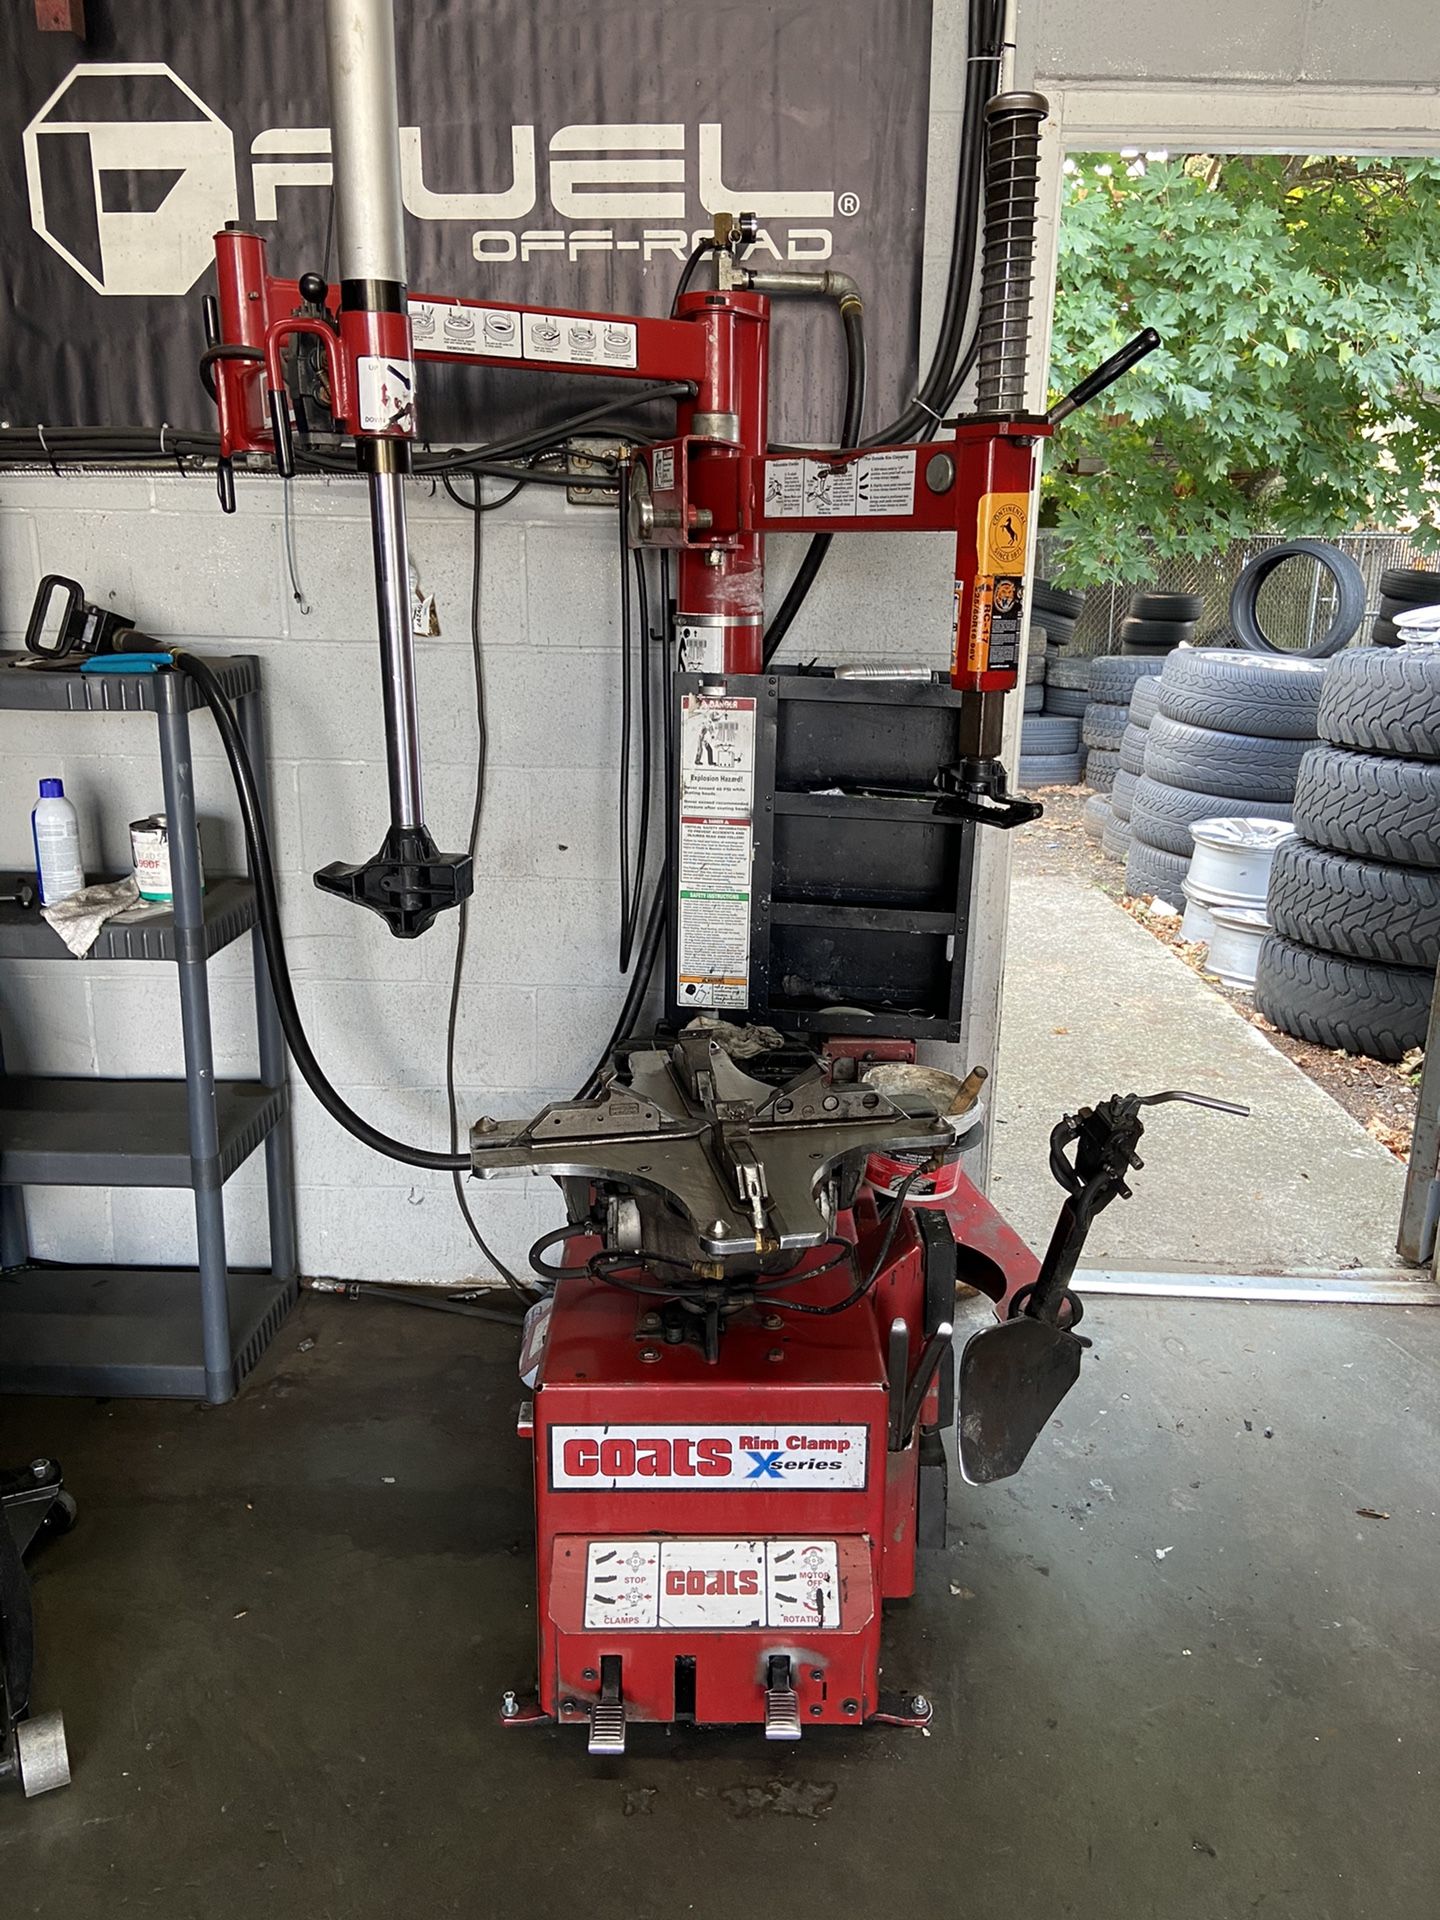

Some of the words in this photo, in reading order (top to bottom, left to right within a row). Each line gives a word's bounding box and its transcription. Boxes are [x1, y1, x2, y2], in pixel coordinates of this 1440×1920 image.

[993, 506, 1026, 526] CONTINENTAL
[739, 1435, 779, 1450] Rim
[786, 1435, 851, 1453] Clamp
[604, 1617, 640, 1625] CLAMPS
